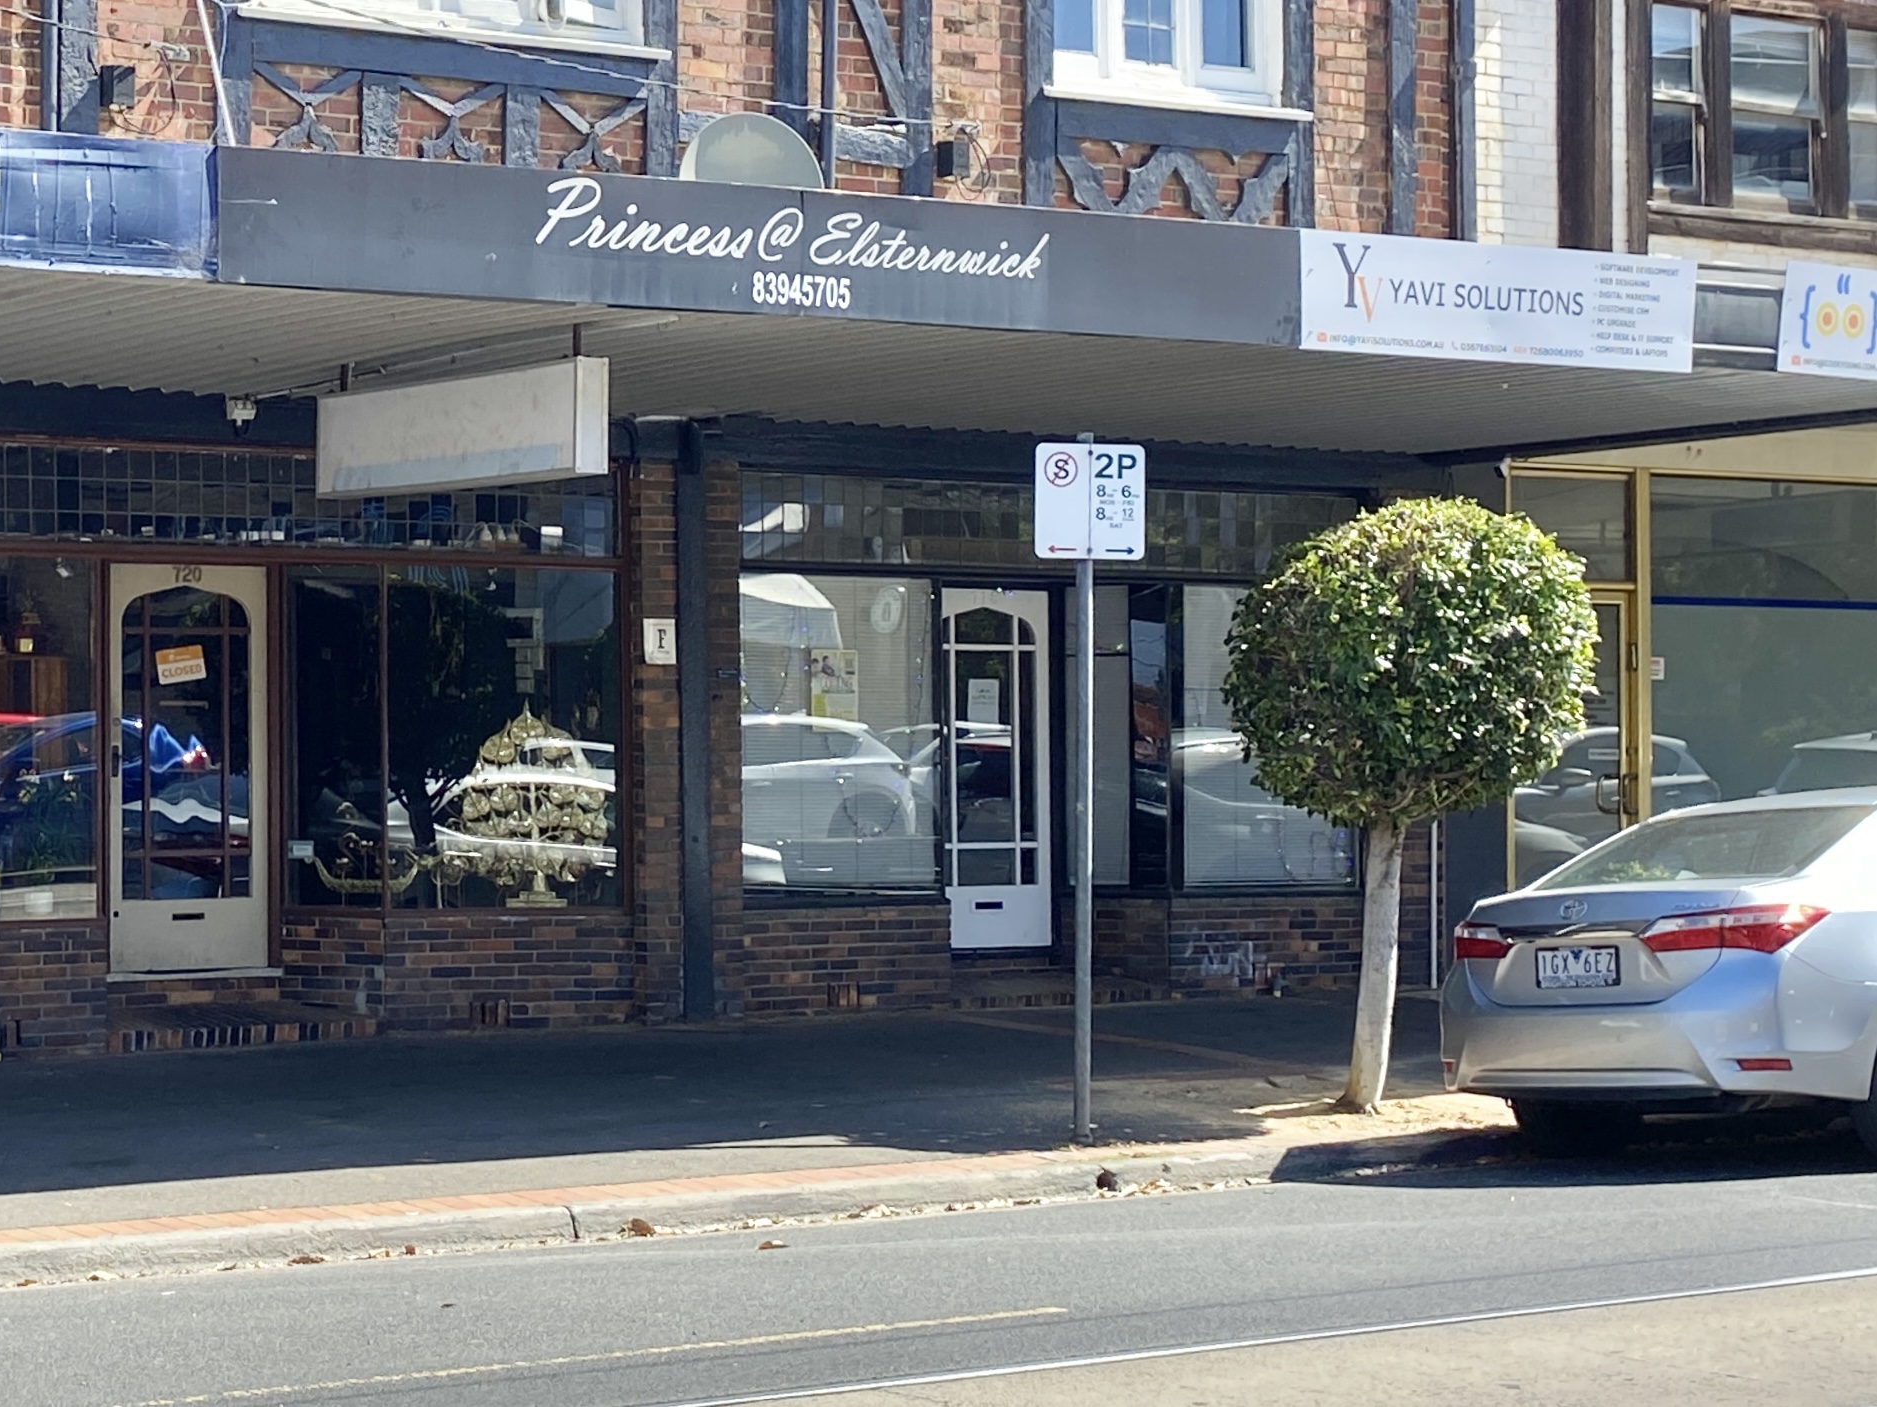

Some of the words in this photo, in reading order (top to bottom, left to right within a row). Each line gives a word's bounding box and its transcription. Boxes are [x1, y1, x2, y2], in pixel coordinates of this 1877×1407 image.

[810, 212, 1050, 279] Elsternwick
[752, 271, 851, 309] 83945705
[1389, 278, 1446, 307] YAVI
[1453, 283, 1584, 316] SOLUTIONS
[1094, 453, 1137, 480] 2P
[172, 566, 202, 583] 720
[657, 629, 666, 649] F
[161, 664, 202, 679] CLOSED
[1542, 953, 1570, 974] 1GX
[1584, 952, 1614, 974] 6EZ
